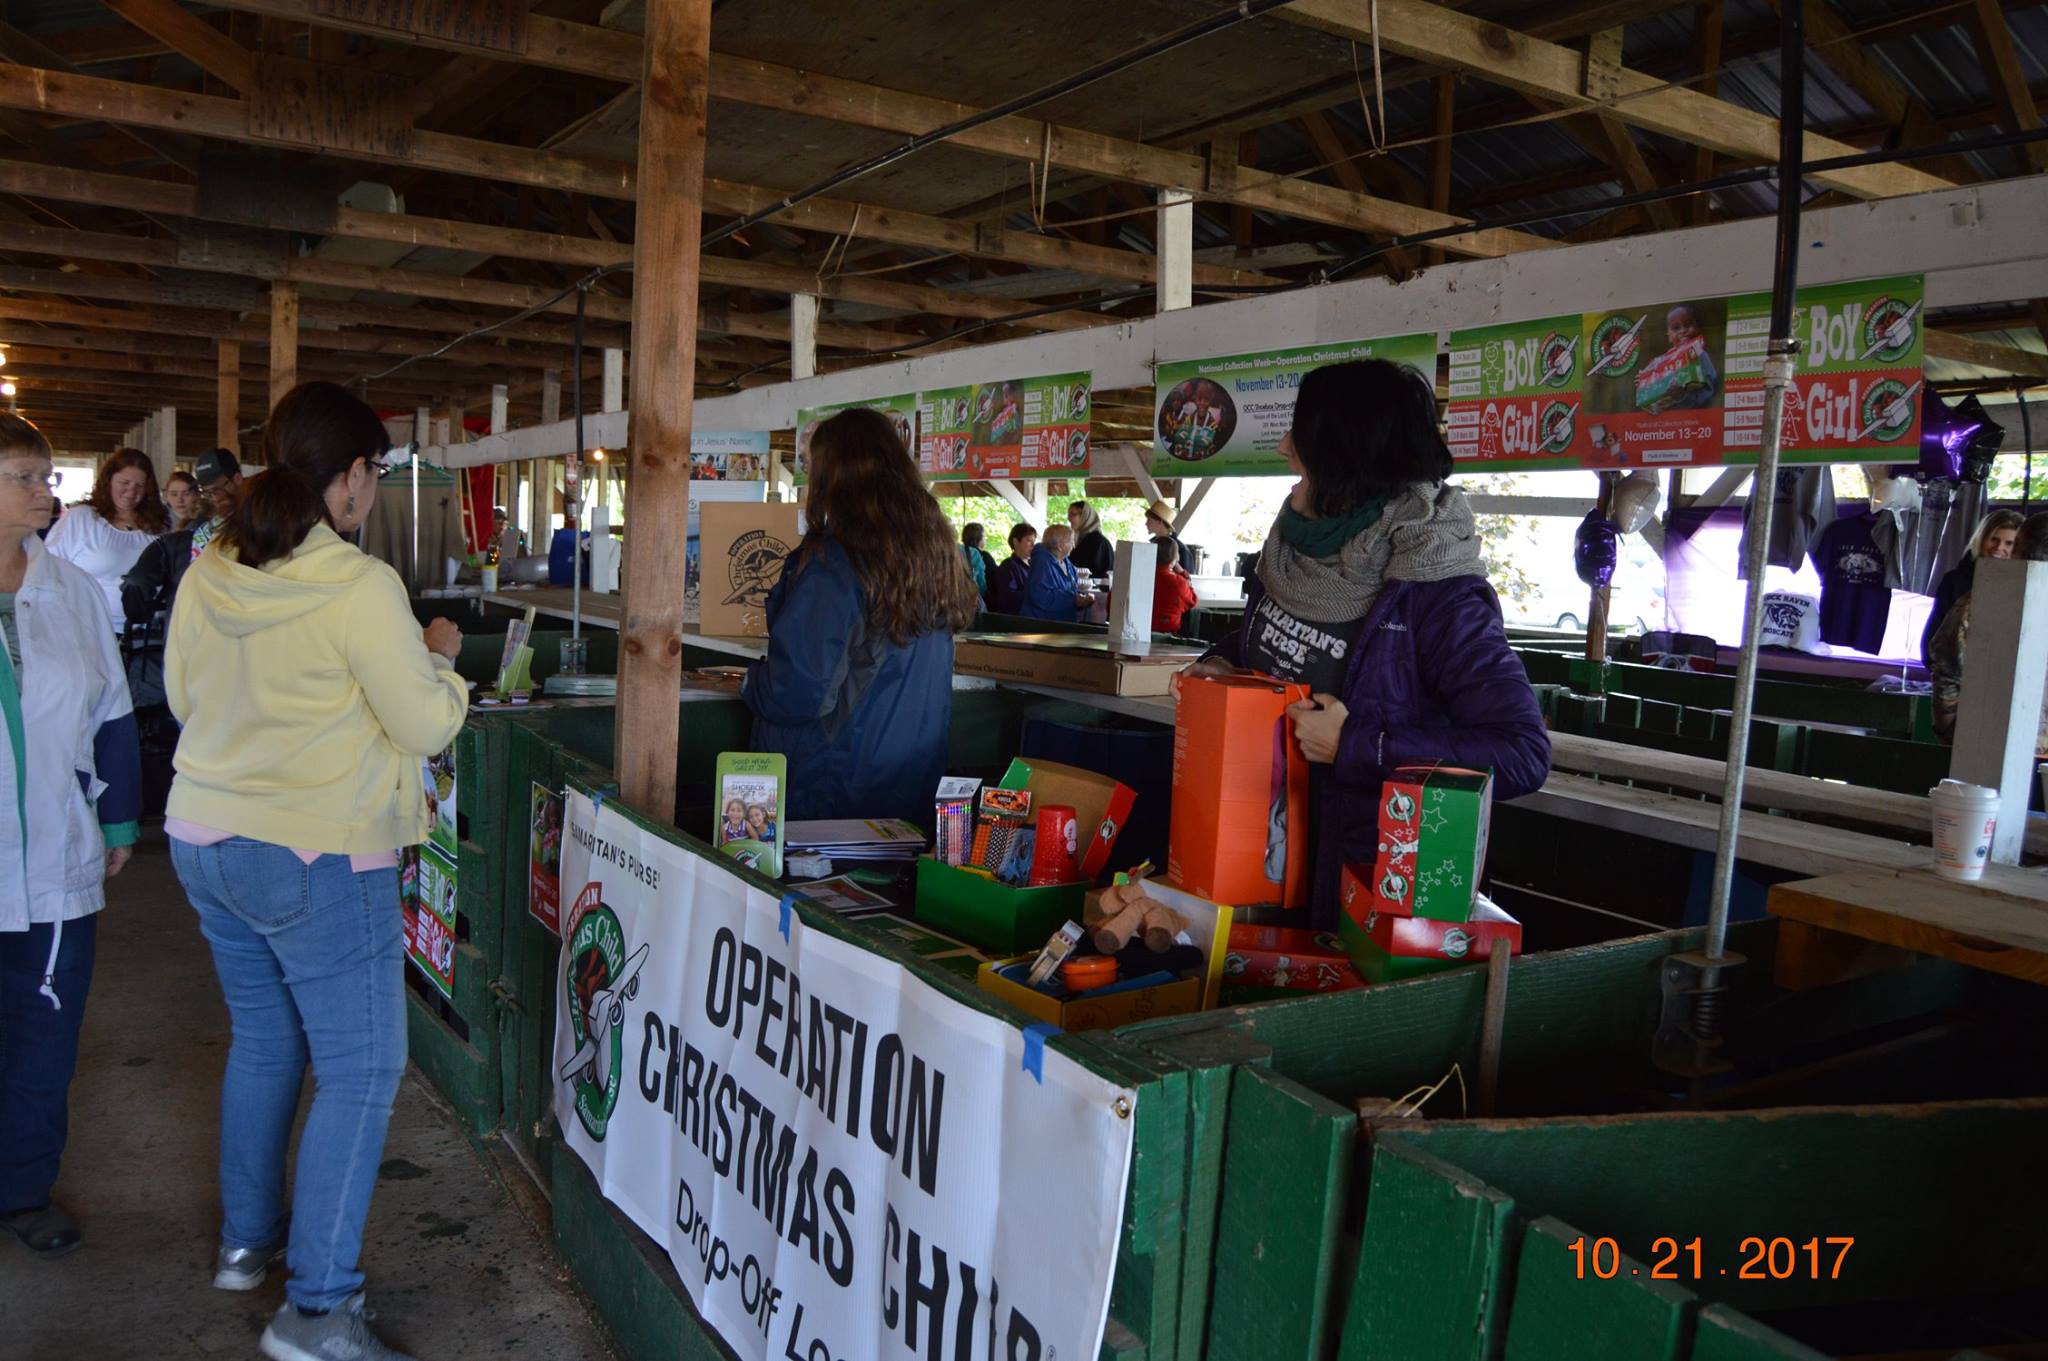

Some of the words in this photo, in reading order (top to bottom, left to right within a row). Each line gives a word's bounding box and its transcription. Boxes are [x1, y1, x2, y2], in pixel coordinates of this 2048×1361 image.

[1199, 362, 1224, 374] National
[1224, 360, 1253, 372] Collection
[1312, 348, 1350, 363] Christmas
[1350, 346, 1373, 358] Child
[1235, 375, 1274, 393] November
[1501, 400, 1538, 454] Girl
[1807, 378, 1859, 443] Girl
[729, 436, 752, 446] Name
[1049, 428, 1068, 467] Girl
[1624, 429, 1675, 442] November
[734, 541, 759, 586] Christmas
[758, 538, 785, 555] Child
[1783, 595, 1810, 608] HAVEN
[1261, 623, 1308, 666] PURSE
[732, 783, 766, 792] SHOEBOX
[570, 821, 632, 871] SAMARITAN'S
[595, 914, 625, 985] Child
[705, 926, 945, 1198] OPERATION
[638, 1010, 856, 1288] CHRISTMAS
[881, 1201, 1042, 1361] CHI
[676, 1177, 782, 1340] Drop-Off
